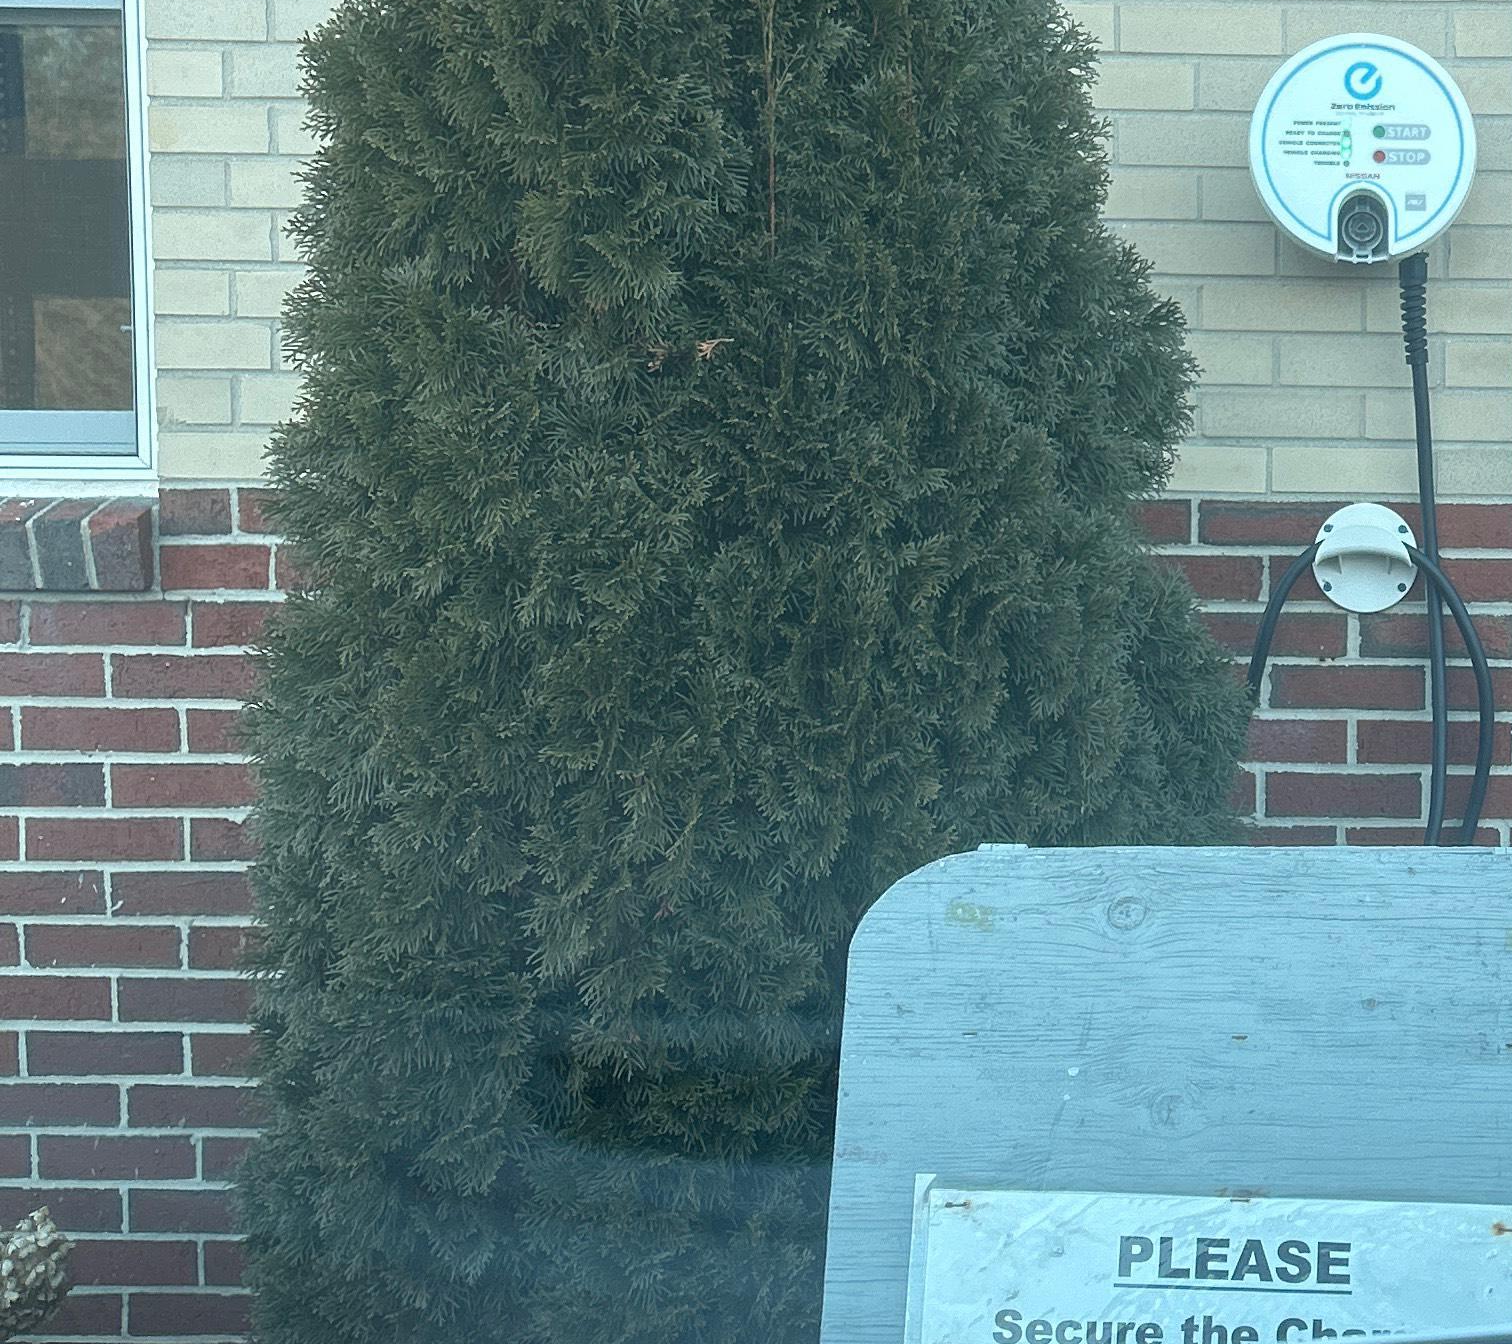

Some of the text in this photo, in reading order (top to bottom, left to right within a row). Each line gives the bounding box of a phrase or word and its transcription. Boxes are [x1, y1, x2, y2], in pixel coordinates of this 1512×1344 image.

[1387, 127, 1428, 138] START
[1389, 151, 1425, 162] STOP
[1118, 1235, 1352, 1285] PLEASE
